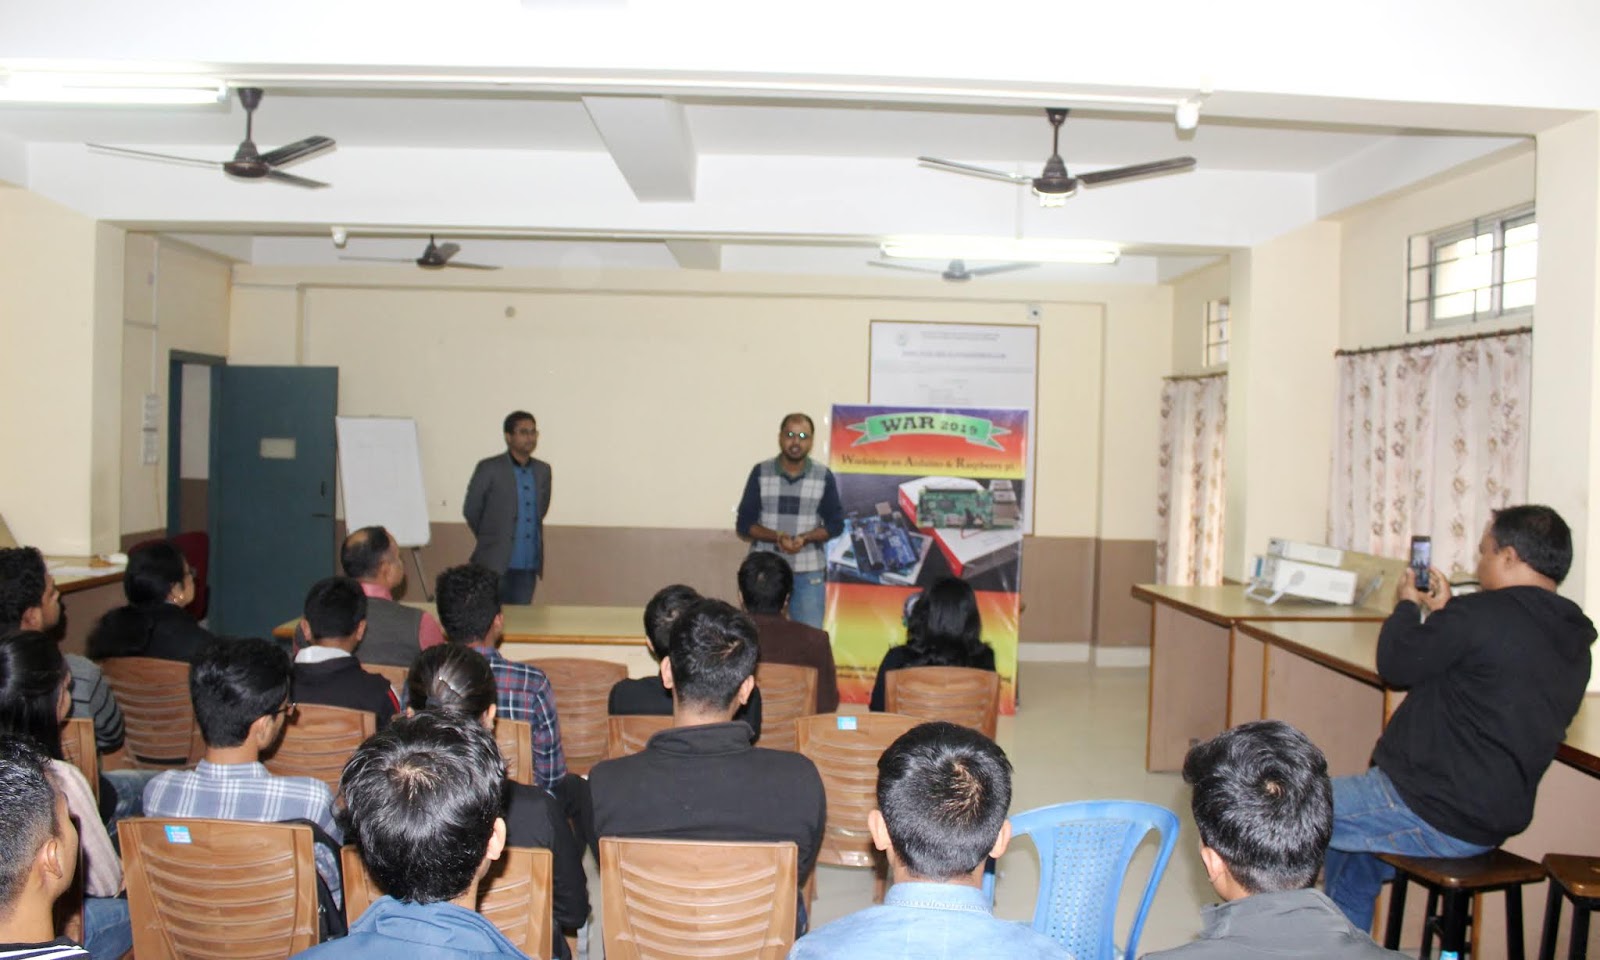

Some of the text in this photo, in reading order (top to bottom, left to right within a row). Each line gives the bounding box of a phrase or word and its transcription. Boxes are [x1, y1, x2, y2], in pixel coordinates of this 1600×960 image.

[880, 416, 978, 436] WAR 2019
[841, 454, 888, 468] Workshop
